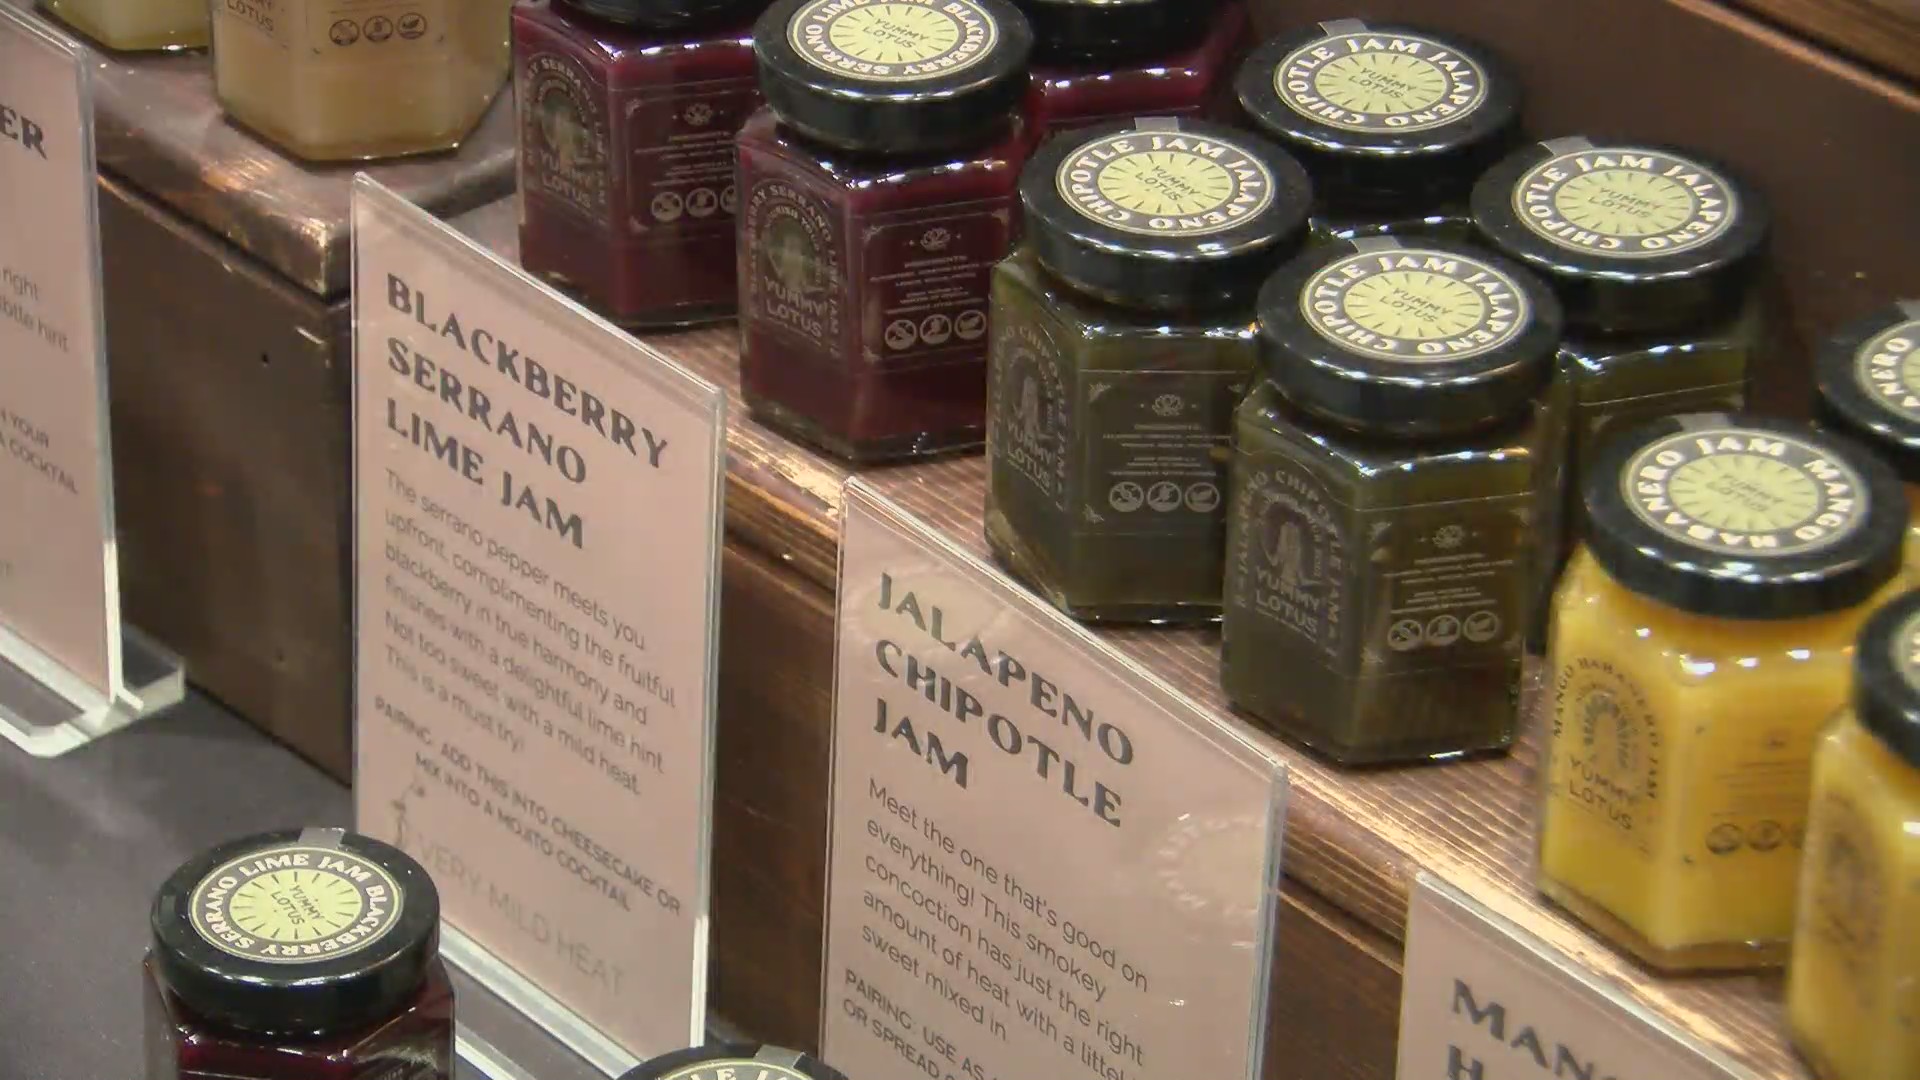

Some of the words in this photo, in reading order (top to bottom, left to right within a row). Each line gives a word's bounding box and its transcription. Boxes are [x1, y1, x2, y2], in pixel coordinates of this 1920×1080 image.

[806, 25, 889, 75] SERRANO
[903, 3, 984, 75] BLACKBERRY
[862, 27, 916, 48] LOTUS
[875, 18, 930, 41] YUMMY
[1347, 38, 1422, 54] JAM
[1288, 47, 1366, 125] CHIPOTLE
[1349, 76, 1404, 99] LOTUS
[1360, 68, 1417, 92] YUMMY
[1384, 52, 1474, 127] JALAPENO
[1071, 139, 1134, 222] CHIPOTLE
[1150, 165, 1201, 196] YUMMY
[1151, 136, 1226, 158] JAM
[1135, 172, 1183, 201] LOTUS
[1148, 159, 1261, 230] JALAPENO
[1526, 167, 1621, 249] CHIPOTLE
[1576, 155, 1653, 172] JAM
[1641, 165, 1721, 249] JALAPENO
[1588, 196, 1653, 218] LOTUS
[1600, 187, 1663, 210] YUMMY
[764, 276, 828, 315] YUMMY
[1378, 256, 1459, 273] JAM
[1393, 287, 1453, 315] YUMMY
[765, 299, 823, 338] LOTUS
[1314, 264, 1397, 350] CHIPOTLE
[1379, 296, 1438, 323] LOTUS
[1417, 272, 1513, 354] JALAPENO
[388, 273, 667, 468] BLACKBERRY
[388, 337, 586, 484] SERRANO
[1696, 437, 1785, 456] JAM
[387, 398, 483, 485] LIME
[501, 471, 583, 549] JAM
[1007, 443, 1051, 488] LOTUS
[1638, 450, 1778, 549] HABANERO
[1795, 459, 1853, 540] MANGO
[385, 467, 417, 504] The
[421, 496, 483, 547] serrano
[487, 539, 549, 586] pepper
[553, 579, 609, 628] meets
[613, 617, 645, 650] you
[1256, 565, 1321, 612] YUMMY
[385, 540, 471, 615] blackberry
[476, 603, 490, 624] in
[496, 612, 529, 649] true
[533, 637, 609, 704] harmony
[614, 693, 647, 725] and
[1255, 590, 1318, 636] LOTUS
[385, 611, 415, 646] Not
[419, 633, 446, 666] too
[505, 696, 539, 728] with
[543, 719, 553, 737] a
[557, 727, 595, 766] mild
[438, 684, 449, 702] a
[489, 646, 499, 666] a
[503, 655, 582, 719] delightful
[588, 706, 625, 748] lime
[585, 633, 613, 666] the
[618, 653, 676, 708] fruitful
[878, 572, 1133, 765] JALAPENO
[873, 697, 968, 790] JAM
[875, 639, 1122, 827] CHIPOTLE
[441, 742, 472, 772] ADD
[476, 760, 509, 799] THIS
[511, 789, 548, 824] INTO
[551, 816, 654, 897] CHEESECAKE
[657, 887, 681, 916] OR
[1569, 779, 1633, 831] LOTUS
[240, 853, 310, 877] LIME
[318, 855, 372, 883] JAM
[484, 799, 493, 816] A
[556, 849, 631, 912] COCKTAIL
[869, 777, 918, 830] Meet
[923, 816, 954, 853] the
[960, 849, 997, 885] one
[1004, 873, 1057, 928] that's
[1062, 919, 1115, 970] good
[1122, 963, 1148, 993] on
[206, 876, 255, 949] SERRANO
[261, 884, 387, 956] BLACKBERRY
[270, 891, 305, 925] LOTUS
[289, 884, 324, 921] YUMMY
[489, 882, 549, 944] MILD
[557, 926, 626, 996] HEAT
[867, 818, 974, 908] everything!
[981, 893, 1021, 939] This
[1026, 932, 1106, 1003] smokey
[861, 924, 919, 979] sweet
[925, 968, 984, 1026] mixed
[990, 1013, 1006, 1041] in
[864, 890, 937, 954] amount
[942, 946, 963, 970] of
[967, 959, 1010, 1007] heat
[1016, 998, 1058, 1043] with
[1063, 1034, 1075, 1054] a
[866, 855, 972, 944] concoction
[978, 927, 1012, 971] has
[1014, 958, 1053, 1002] just
[1058, 986, 1091, 1027] the
[1096, 1020, 1143, 1066] right
[843, 998, 868, 1027] OR
[872, 1019, 940, 1079] SPREAD
[922, 1026, 957, 1064] USE
[961, 1057, 984, 1080] AS
[1453, 978, 1617, 1080] MAN
